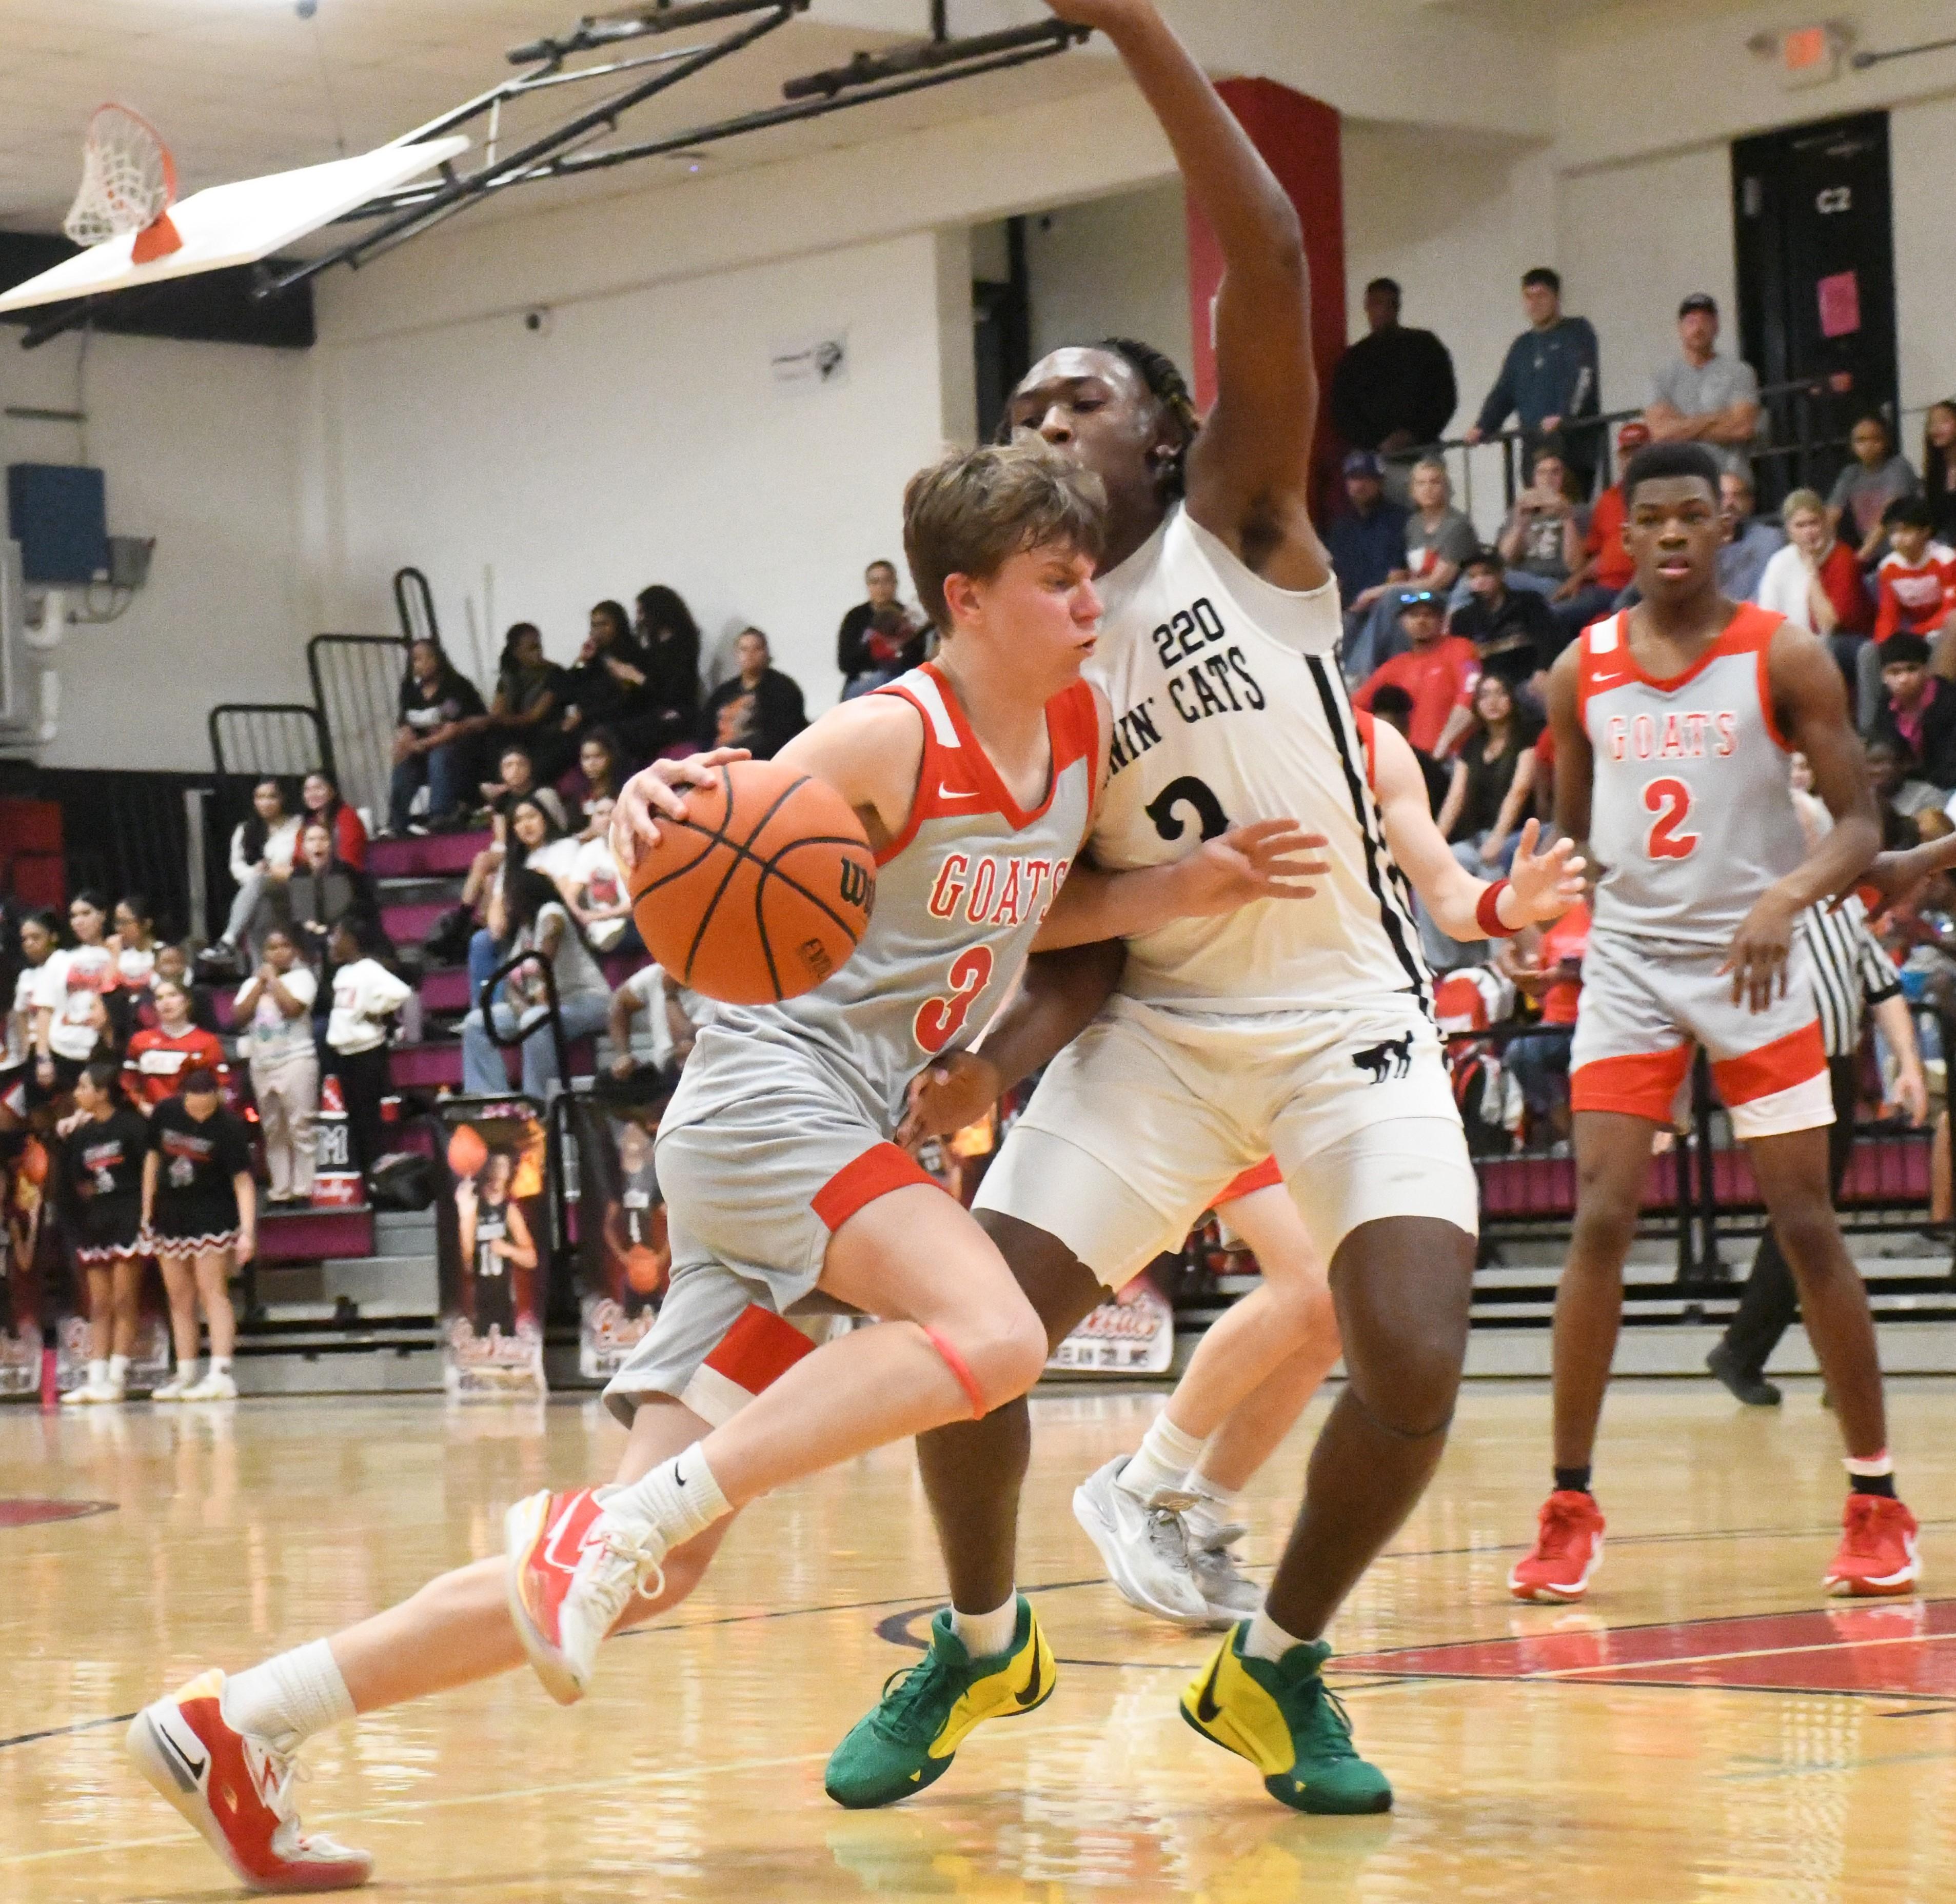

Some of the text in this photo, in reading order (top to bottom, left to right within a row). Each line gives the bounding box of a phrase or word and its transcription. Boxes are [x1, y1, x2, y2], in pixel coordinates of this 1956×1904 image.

[1153, 597, 1225, 669] 220
[1103, 647, 1265, 789] NIN' CATS
[1604, 711, 1737, 763] GOATS
[1641, 776, 1702, 861] 2
[913, 944, 994, 1055] 3
